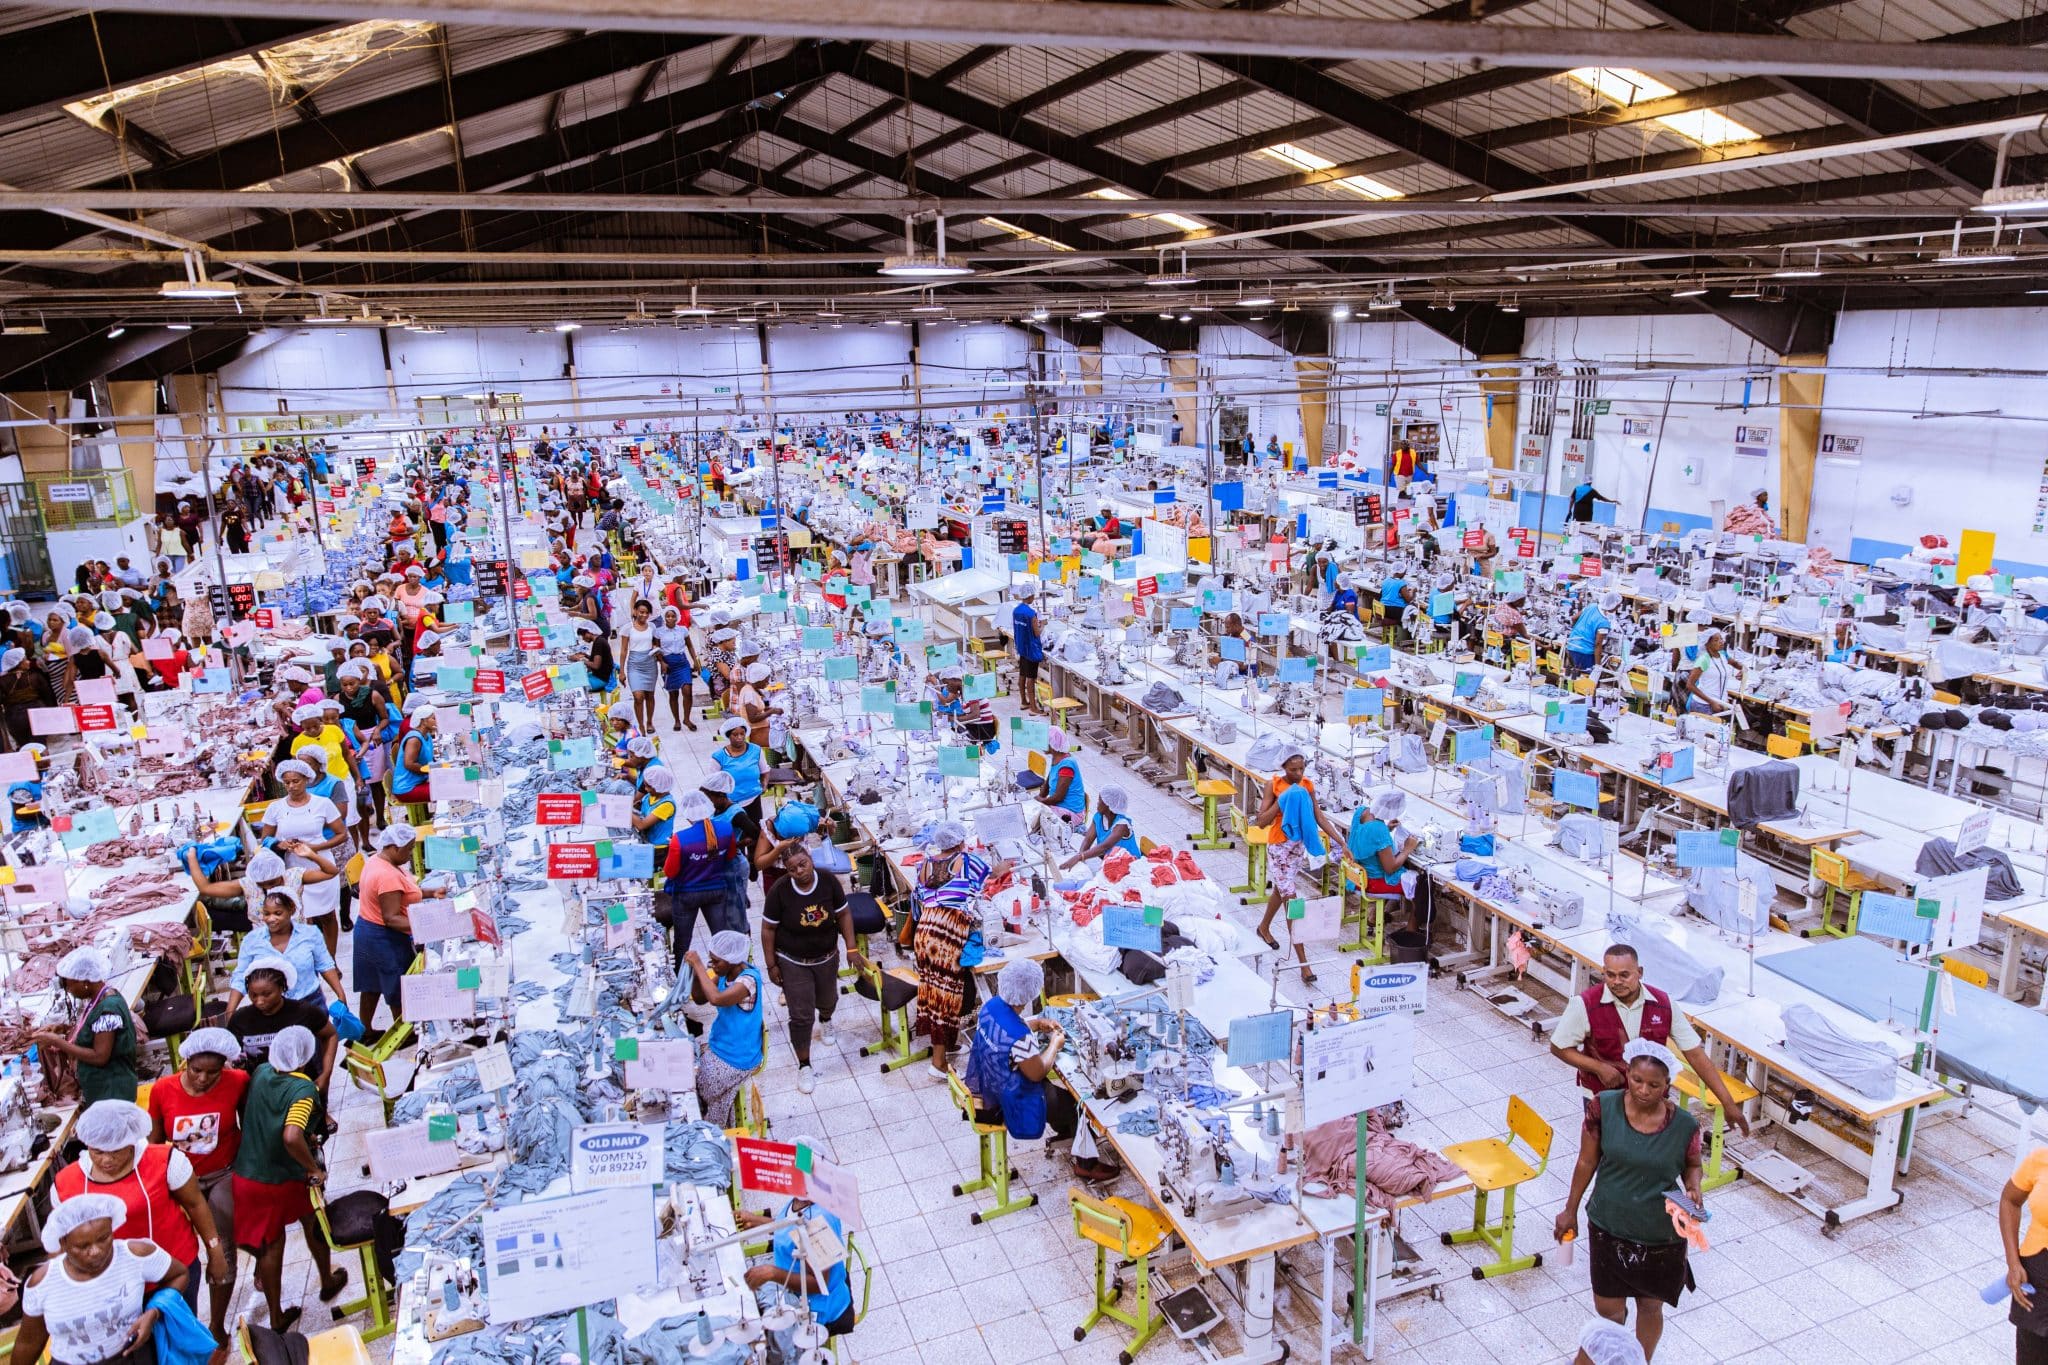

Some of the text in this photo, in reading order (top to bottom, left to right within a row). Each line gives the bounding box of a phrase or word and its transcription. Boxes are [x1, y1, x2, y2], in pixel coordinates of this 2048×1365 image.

[1564, 453, 1584, 462] TOUCHE
[1388, 976, 1412, 984] NAVY
[1380, 995, 1406, 1004] GIRL'S
[588, 1136, 642, 1149] OLD NAVY
[590, 1151, 643, 1163] WOMEN'S
[588, 1161, 647, 1175] S/# 892247
